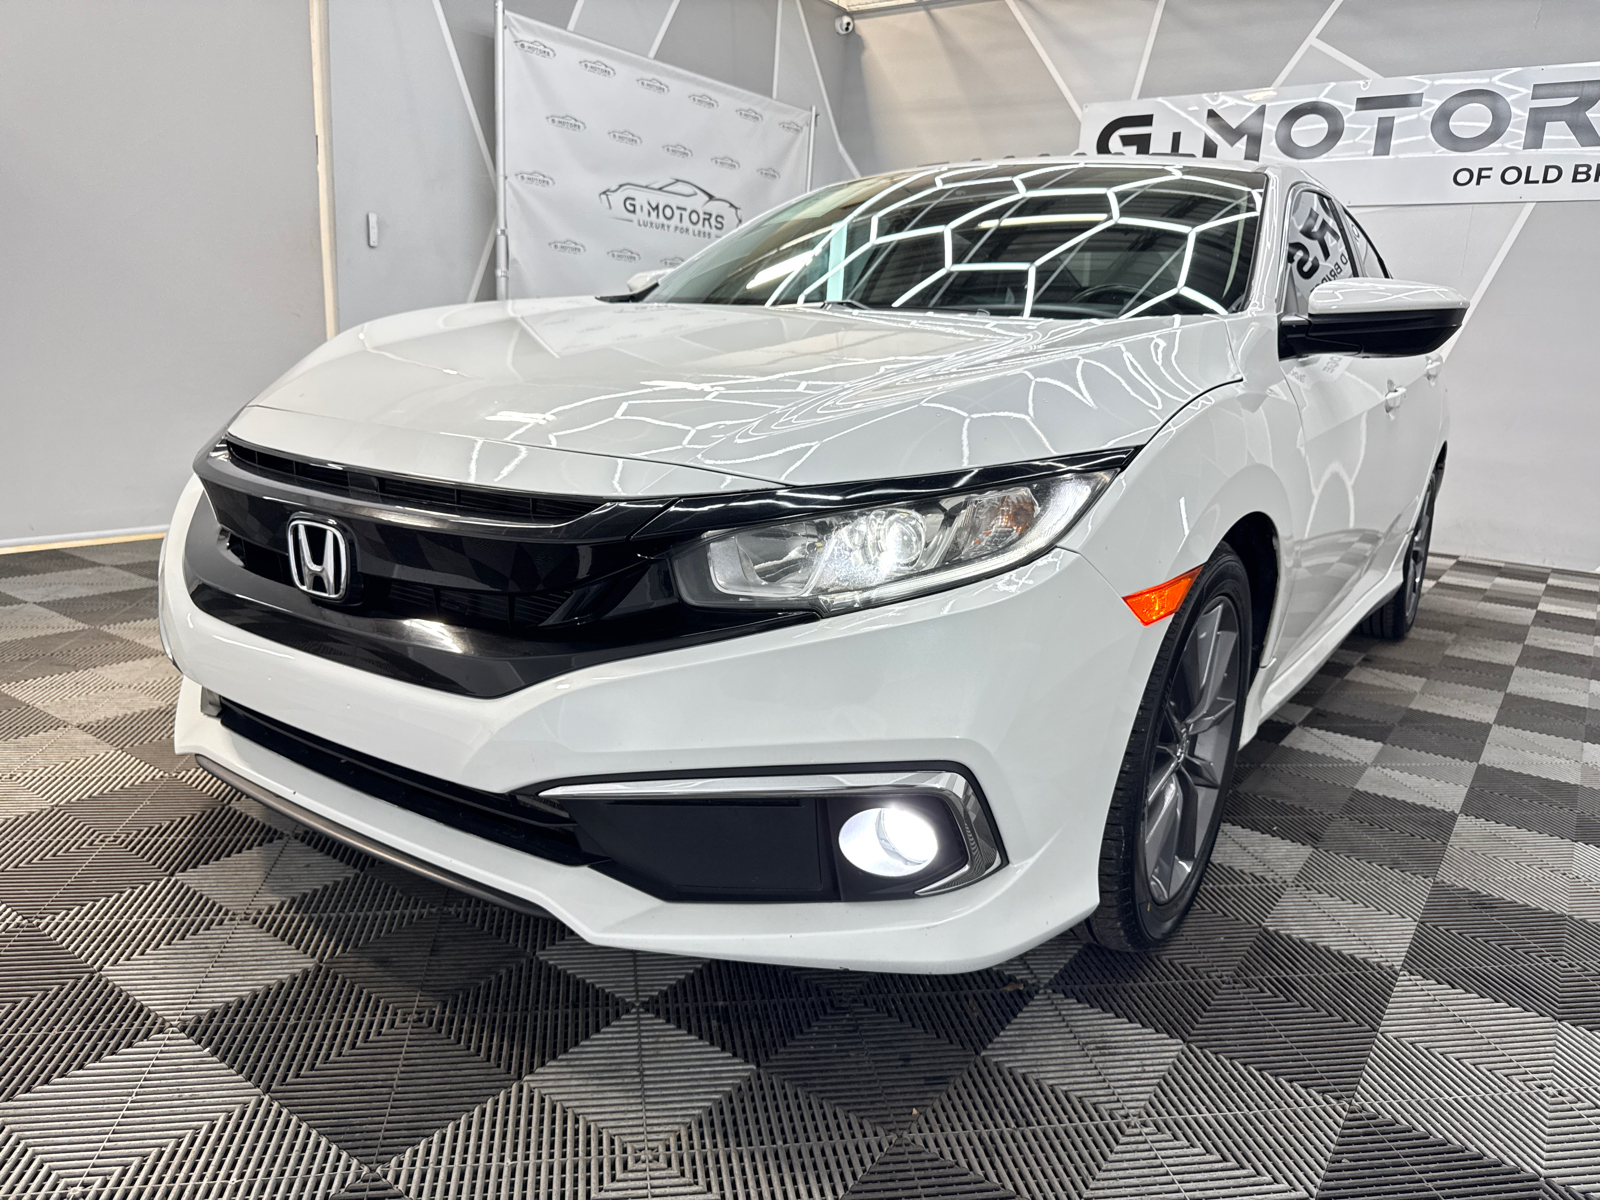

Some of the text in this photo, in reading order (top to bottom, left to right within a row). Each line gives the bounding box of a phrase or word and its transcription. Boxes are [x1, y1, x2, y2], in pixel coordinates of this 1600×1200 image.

[1452, 167, 1493, 187] OF
[1500, 165, 1563, 185] OLD
[637, 219, 712, 240] LUXURY FOR LESS
